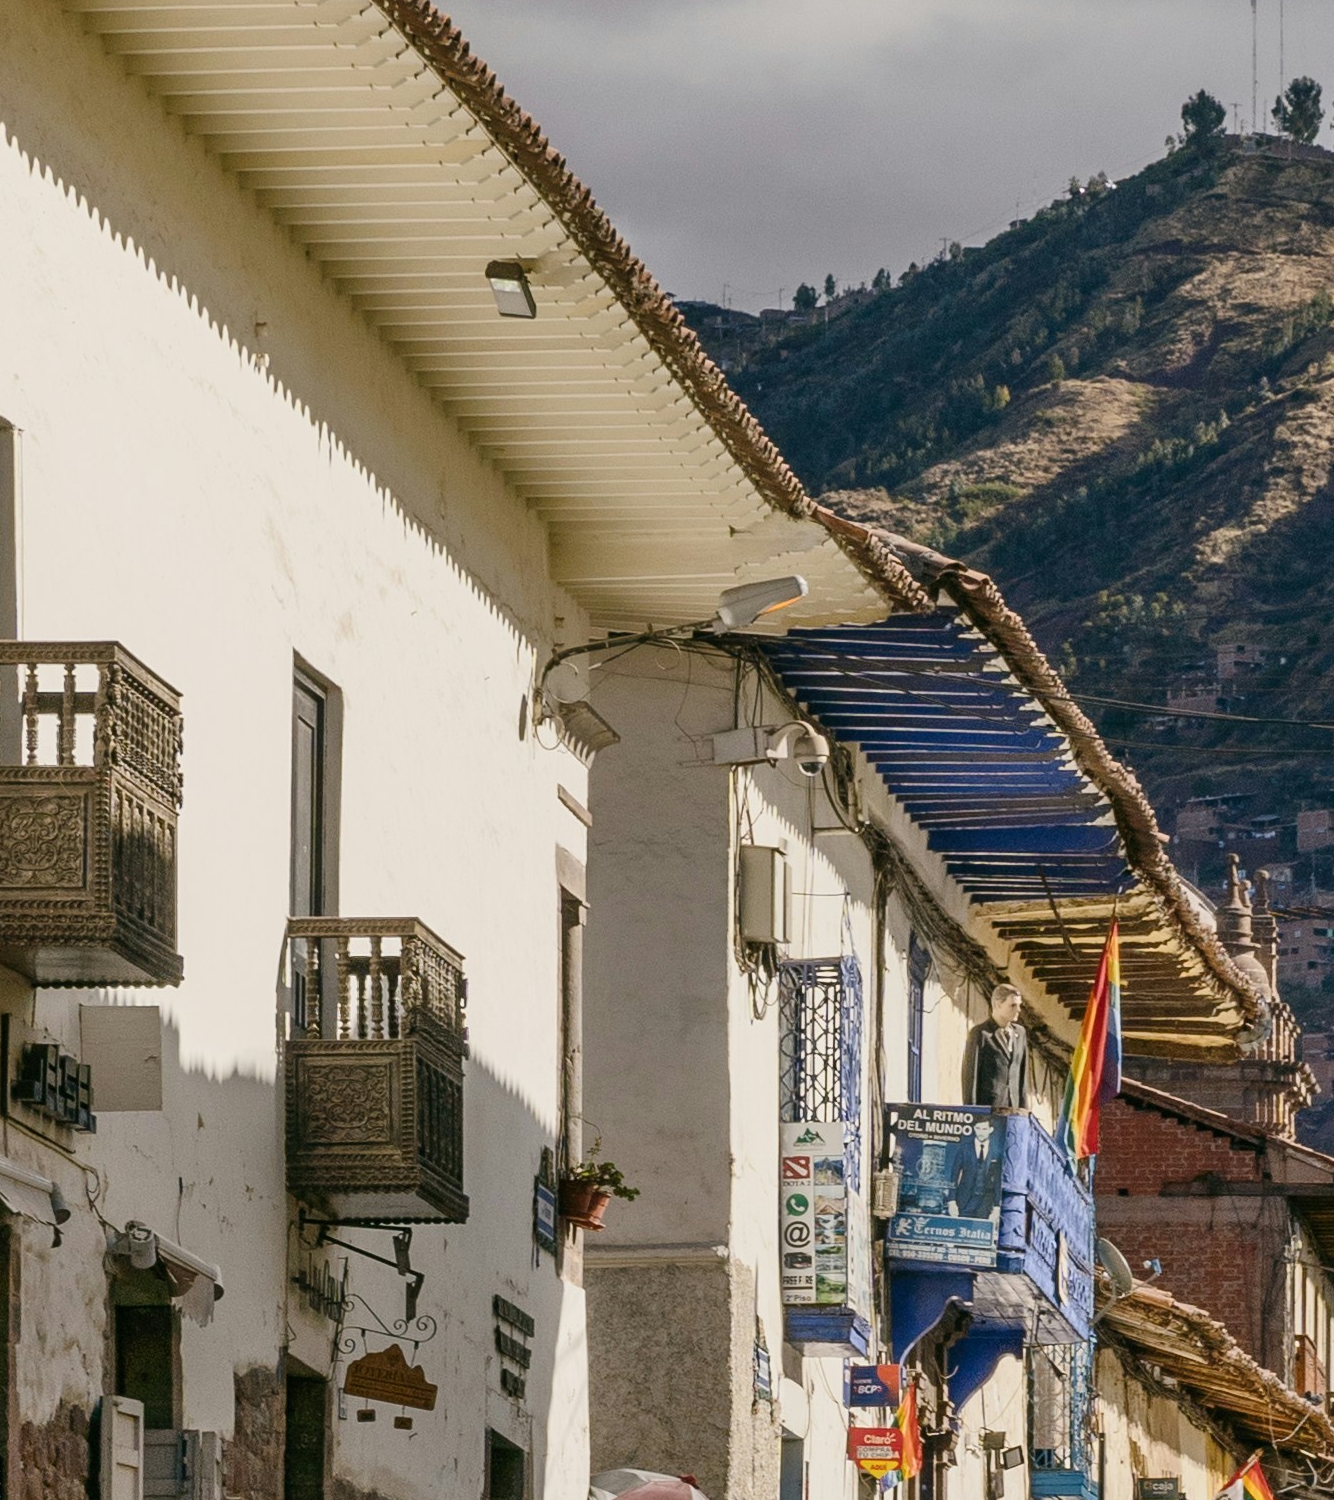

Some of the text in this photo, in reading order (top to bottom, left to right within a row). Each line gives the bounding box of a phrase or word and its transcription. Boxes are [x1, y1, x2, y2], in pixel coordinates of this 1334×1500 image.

[913, 1109, 974, 1124] AL RITMO
[897, 1119, 973, 1136] DEL MUNDO
[914, 1223, 991, 1240] Ternos Italia
[783, 1276, 813, 1285] FREE FRE
[857, 1385, 878, 1394] BCP
[864, 1434, 892, 1445] Claro
